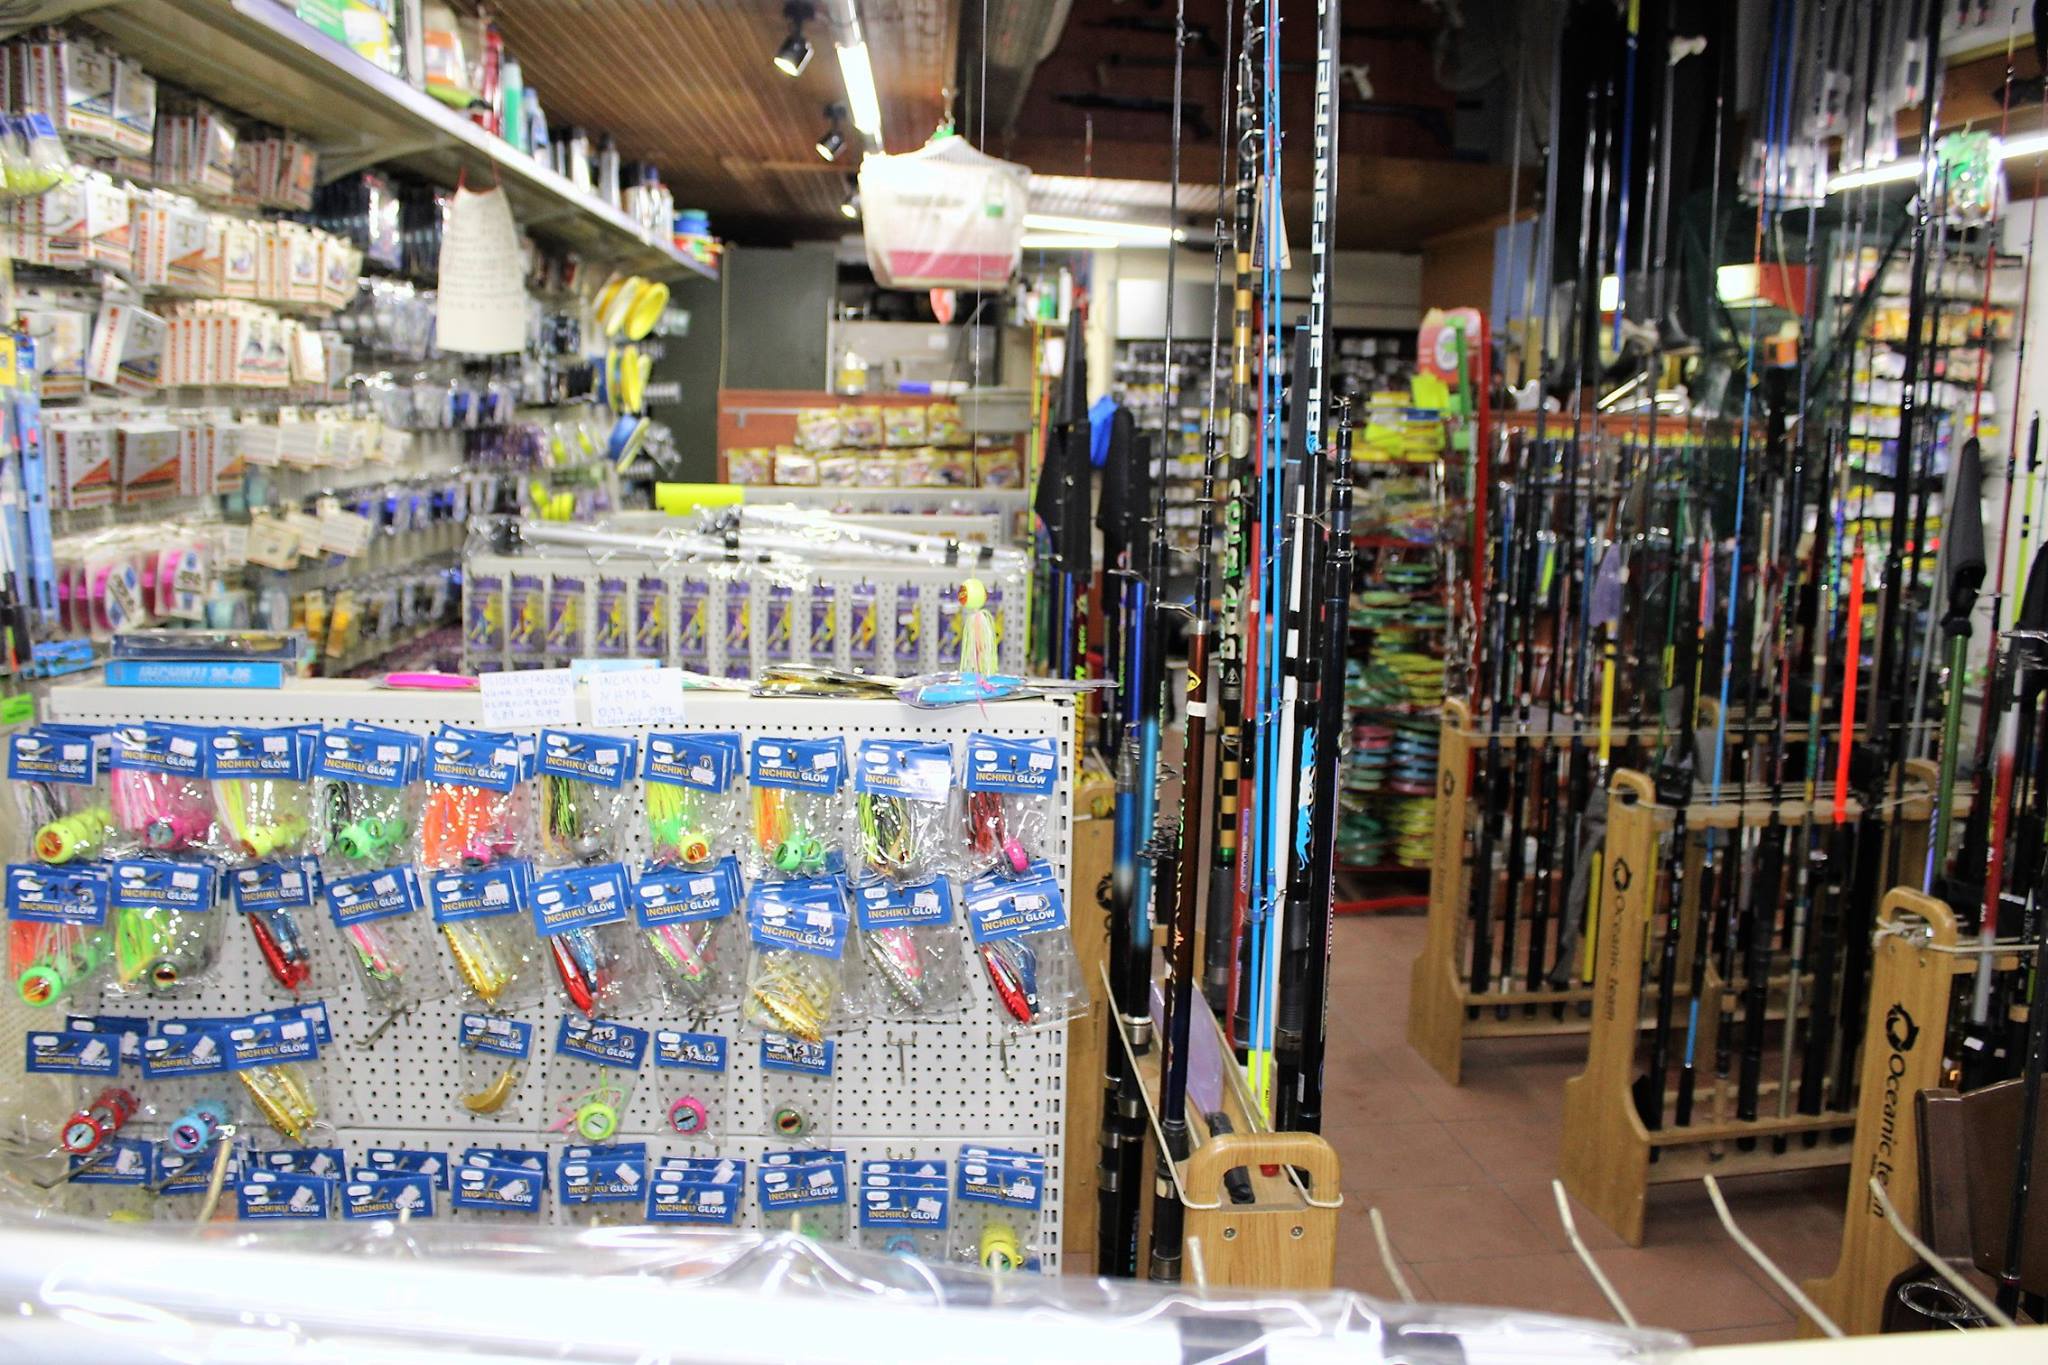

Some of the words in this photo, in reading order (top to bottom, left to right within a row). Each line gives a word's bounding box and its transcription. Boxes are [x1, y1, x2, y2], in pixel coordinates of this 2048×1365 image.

[121, 750, 165, 763] INCHIKU
[166, 755, 197, 768] GLOW
[216, 759, 260, 769] INCHIKU
[260, 759, 291, 769] GLOW
[17, 761, 57, 773] INCHIKU
[58, 763, 86, 774] GLOW
[324, 759, 366, 774] INCHIKU
[367, 766, 397, 777] GLOW
[434, 763, 477, 776] INCHIKU
[478, 768, 507, 780] GLOW
[546, 757, 587, 771] INCHIKU
[588, 764, 617, 776] GLOW
[652, 763, 690, 776] INCHIKU
[759, 768, 801, 780] INCHIKU
[801, 770, 830, 783] GLOW
[976, 772, 1015, 782] INCHIKU
[1017, 774, 1047, 785] GLOW
[121, 889, 165, 899] INCHIKU
[167, 890, 199, 901] GLOW
[18, 902, 63, 913] INCHIKU
[65, 904, 98, 915] GLOW
[340, 903, 379, 916] INCHIKU
[379, 896, 404, 907] GLOW
[441, 901, 481, 911] INCHIKU
[646, 904, 688, 916] INCHIKU
[689, 898, 720, 910] GLOW
[544, 910, 586, 924] INCHIKU
[587, 902, 616, 914] GLOW
[868, 908, 910, 918] INCHIKU
[982, 917, 1024, 931] INCHIKU
[1025, 910, 1056, 922] GLOW
[761, 925, 803, 941] INCHIKU
[805, 933, 836, 947] GLOW
[236, 1047, 278, 1059] INCHIKU
[280, 1043, 309, 1054] GLOW
[500, 1039, 524, 1050] GLOW
[606, 1048, 636, 1060] GLOW
[802, 1057, 826, 1067] GLOW
[1880, 1053, 1905, 1156] Oceanic
[609, 1184, 638, 1193] GLOW
[810, 1186, 839, 1197] GLOW
[1873, 1156, 1895, 1218] tem
[352, 1203, 394, 1213] INCHIKU
[656, 1204, 697, 1213] INCHIKU
[698, 1204, 727, 1214] GLOW
[868, 1210, 910, 1219] INCHIKU
[911, 1212, 939, 1220] GLOW
